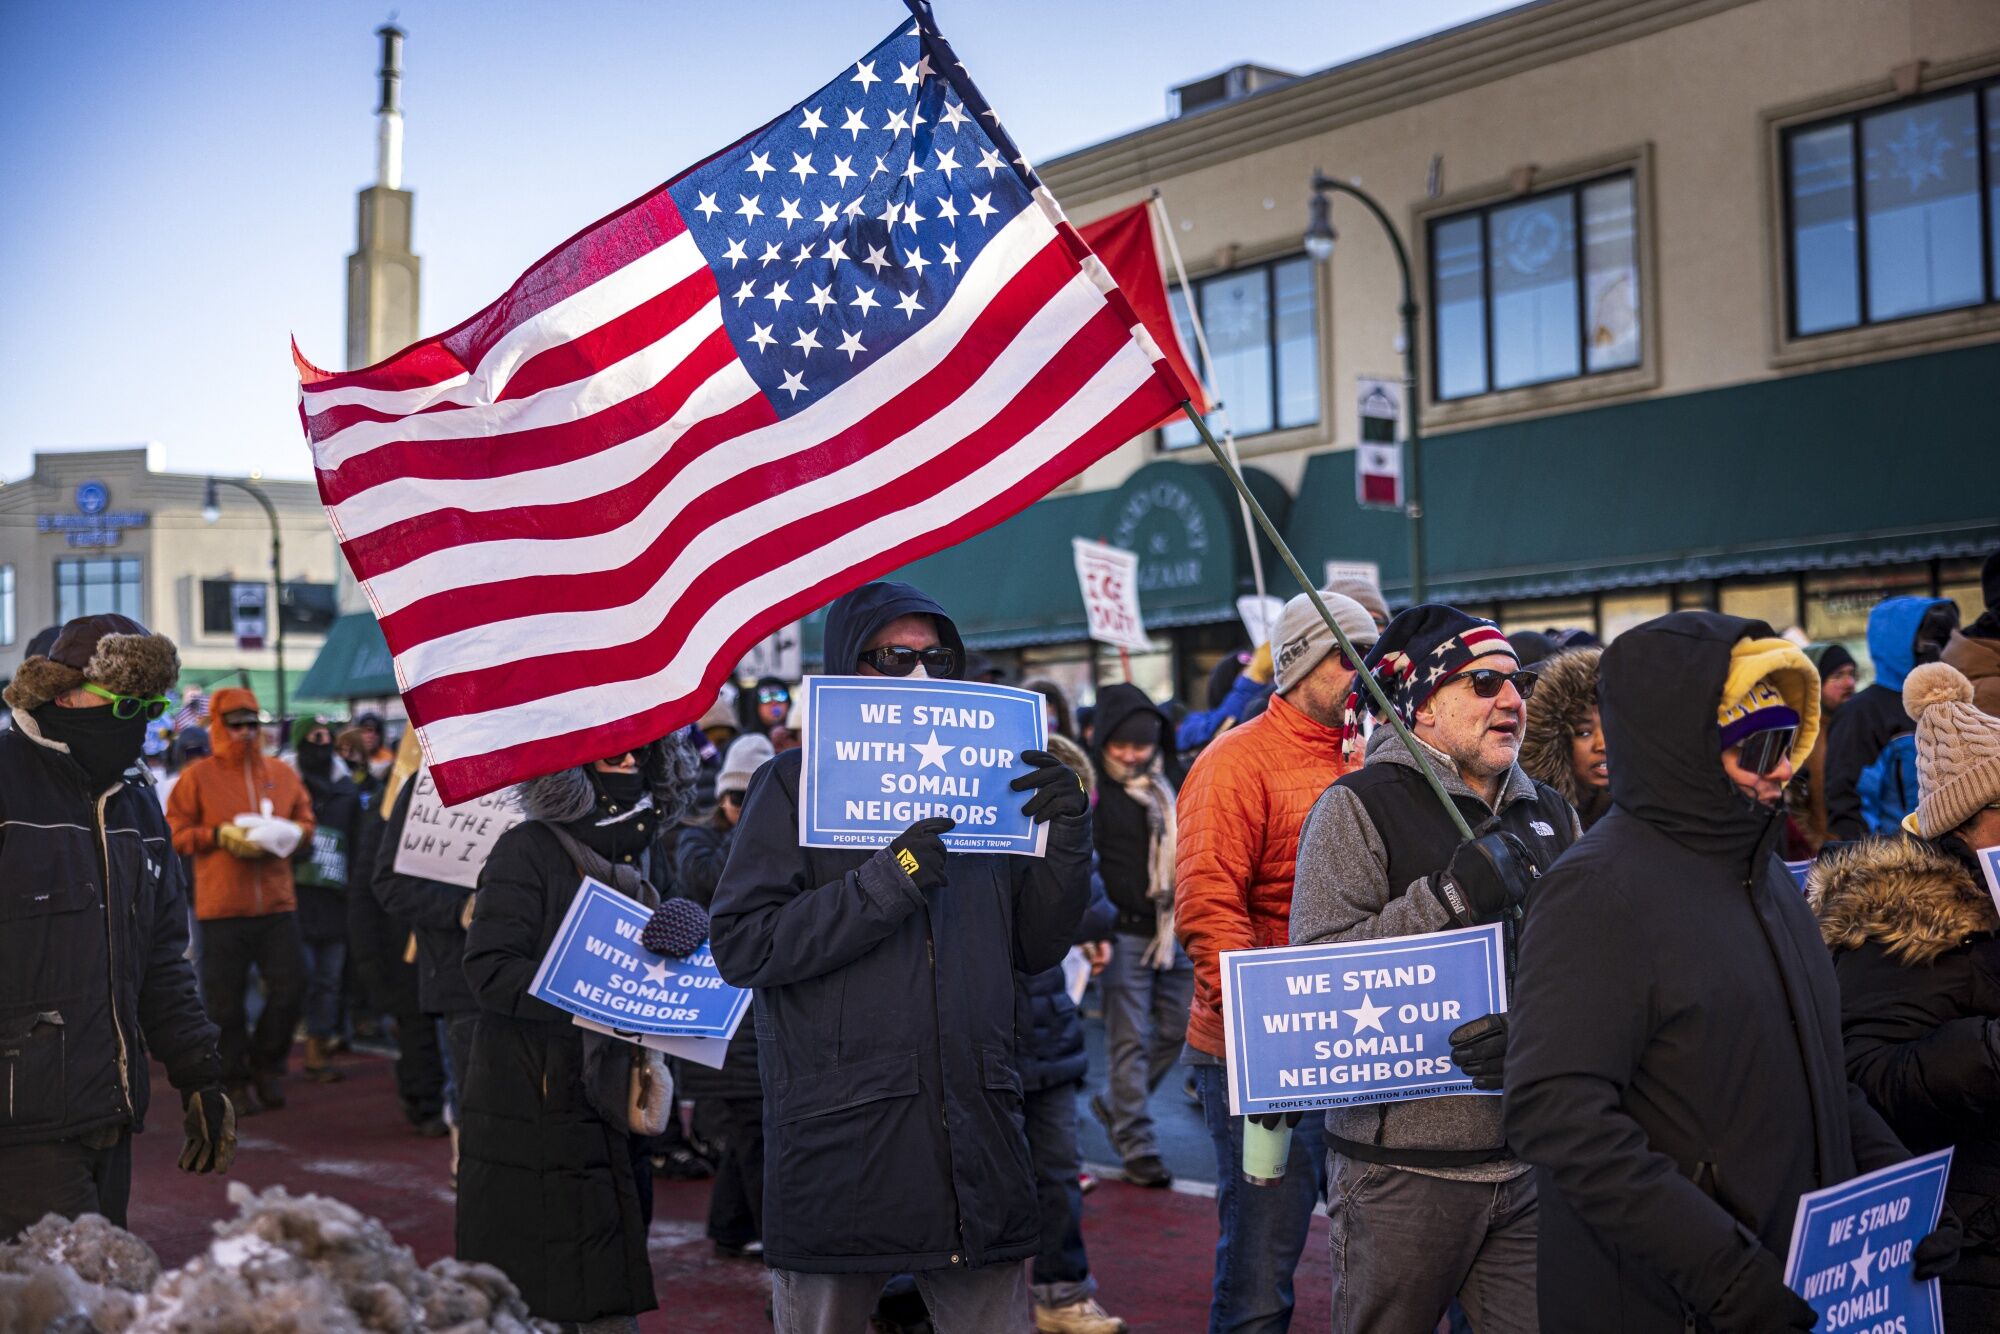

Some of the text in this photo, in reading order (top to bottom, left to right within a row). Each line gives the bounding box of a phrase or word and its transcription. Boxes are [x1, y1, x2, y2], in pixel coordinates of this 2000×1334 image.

[1279, 638, 1309, 667] REI
[860, 704, 995, 729] WE STAND
[835, 741, 1014, 768] WITH OUR
[880, 773, 980, 797] SOMALI
[410, 804, 441, 826] ALL
[449, 812, 493, 836] THE
[845, 800, 997, 825] NEIGHBORS
[403, 833, 452, 857] WHY
[458, 841, 477, 862] I
[833, 834, 875, 843] PEOPLE'S
[954, 838, 985, 848] AGAINST
[987, 839, 1011, 848] TRUMP
[1443, 882, 1465, 914] DULUTH
[585, 935, 723, 990] WITH OUR
[608, 974, 689, 1005] SOMALI
[1286, 964, 1436, 995] WE STAND
[573, 980, 699, 1022] NEIGHBORS
[1263, 1000, 1461, 1033] WITH OUR
[1315, 1034, 1423, 1060] SOMALI
[1279, 1055, 1451, 1087] NEIGHBORS
[1268, 1100, 1313, 1110] PEOPLE'S
[1315, 1097, 1349, 1106] ACTION
[1352, 1091, 1400, 1103] COALITION
[1402, 1086, 1442, 1098] AGAINST
[1828, 1197, 1910, 1247] WE STAND
[1803, 1239, 1913, 1300] WITH OUR
[1826, 1285, 1889, 1332] SOMALI
